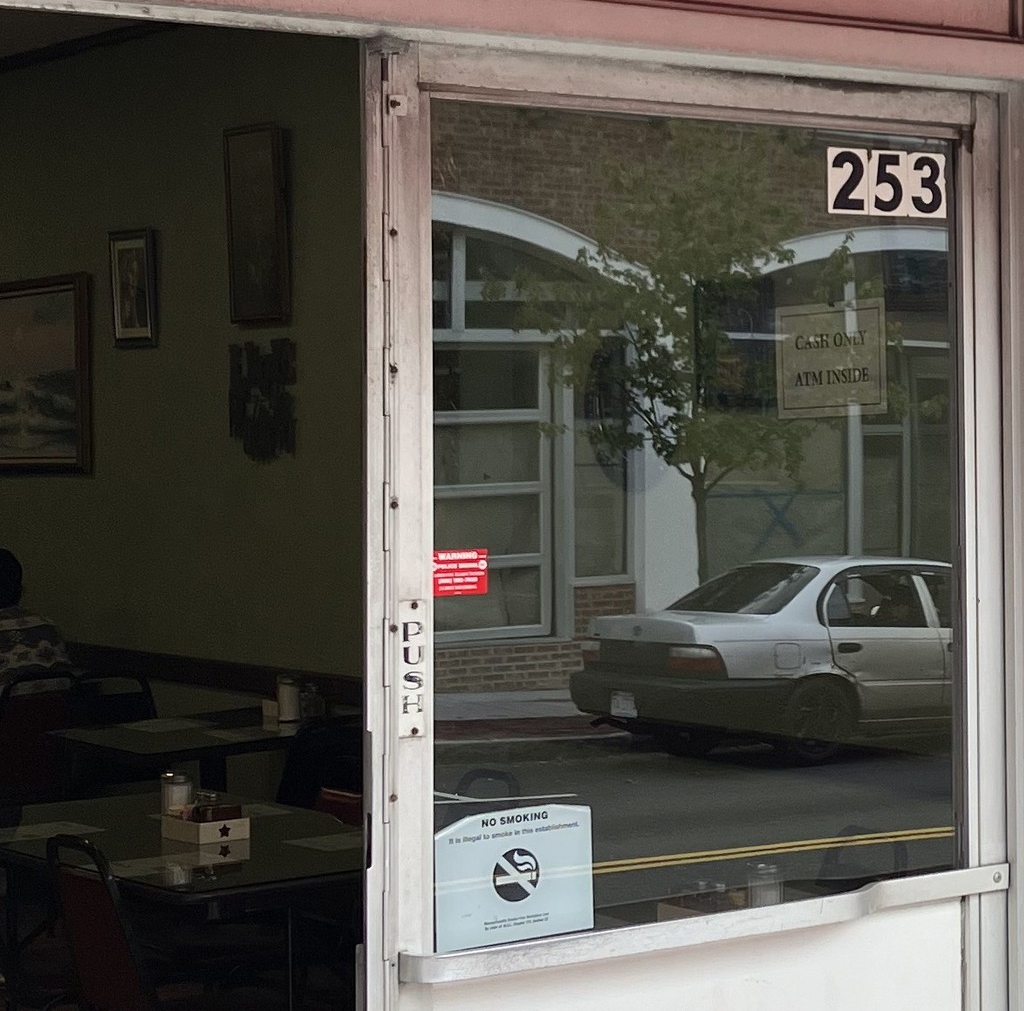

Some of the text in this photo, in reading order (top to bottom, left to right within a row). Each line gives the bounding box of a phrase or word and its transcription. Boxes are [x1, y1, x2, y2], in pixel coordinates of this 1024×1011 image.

[831, 151, 942, 213] 253
[795, 330, 866, 350] CASH ONLY
[795, 367, 869, 387] ATM INSIDE
[438, 551, 478, 560] WARNING
[402, 621, 424, 714] PUSH
[481, 810, 549, 828] NO SMOKING
[491, 830, 513, 839] smoke
[522, 827, 534, 835] this
